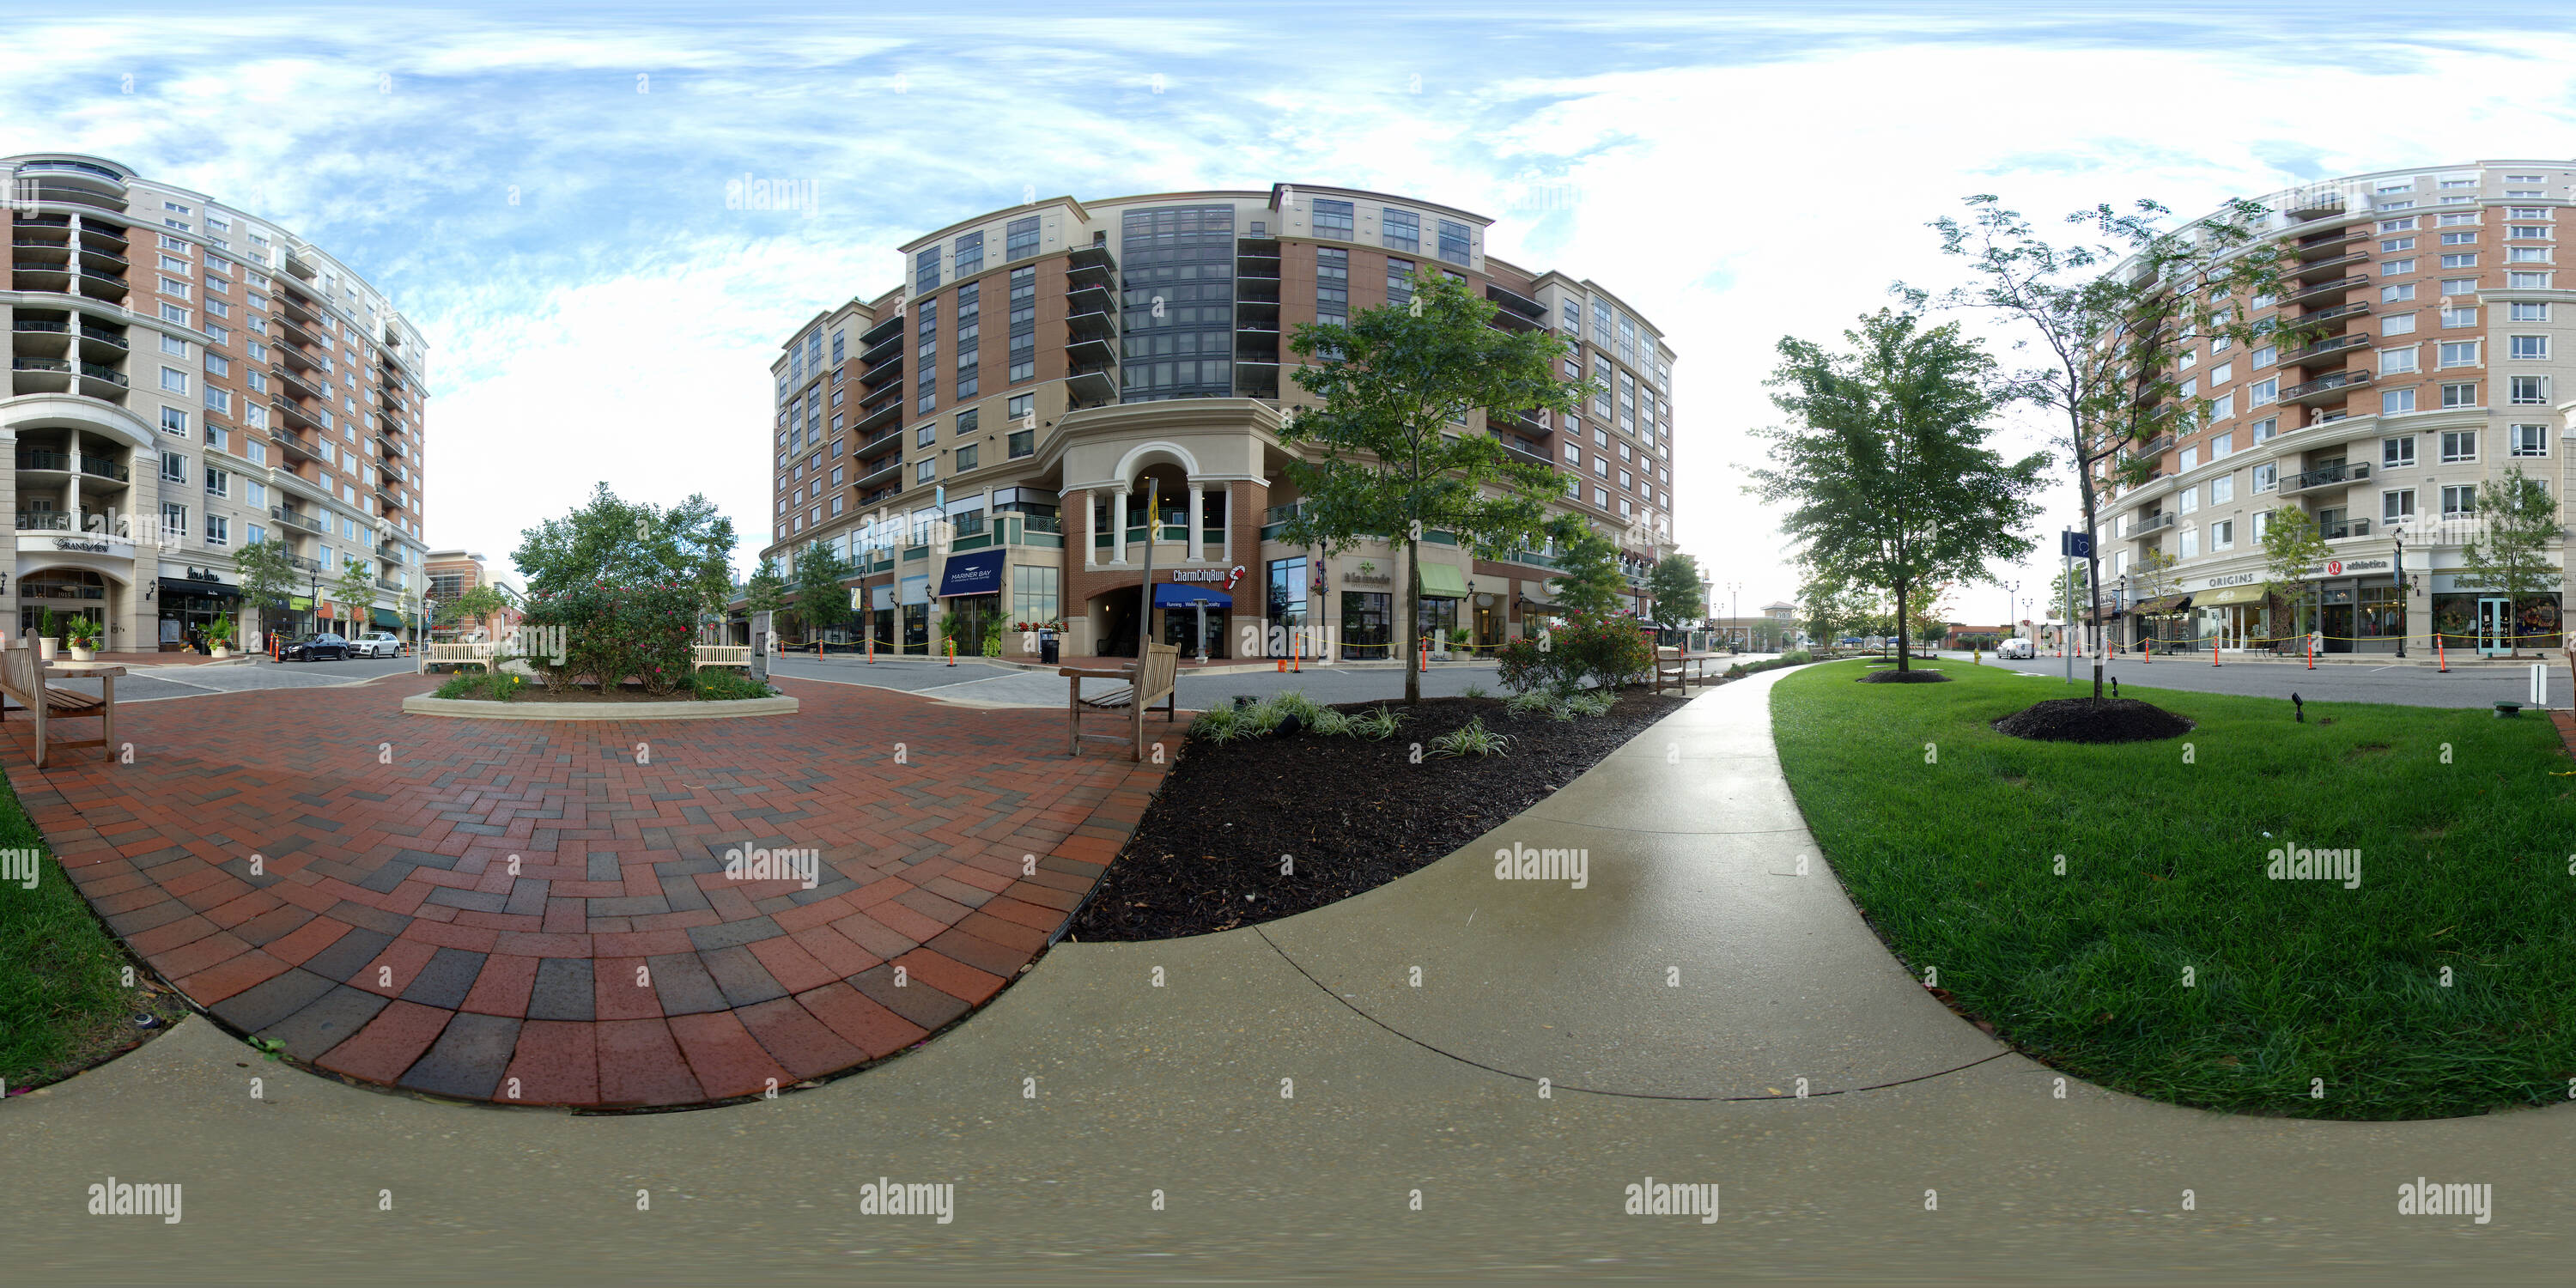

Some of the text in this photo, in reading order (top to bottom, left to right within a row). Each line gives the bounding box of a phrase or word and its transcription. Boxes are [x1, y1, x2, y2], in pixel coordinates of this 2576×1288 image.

[2346, 560, 2387, 570] athletica
[186, 566, 220, 581] lou lou
[951, 571, 978, 580] MARINER
[1173, 568, 1224, 583] CharmCityRun
[2208, 573, 2253, 587] ORIGINS
